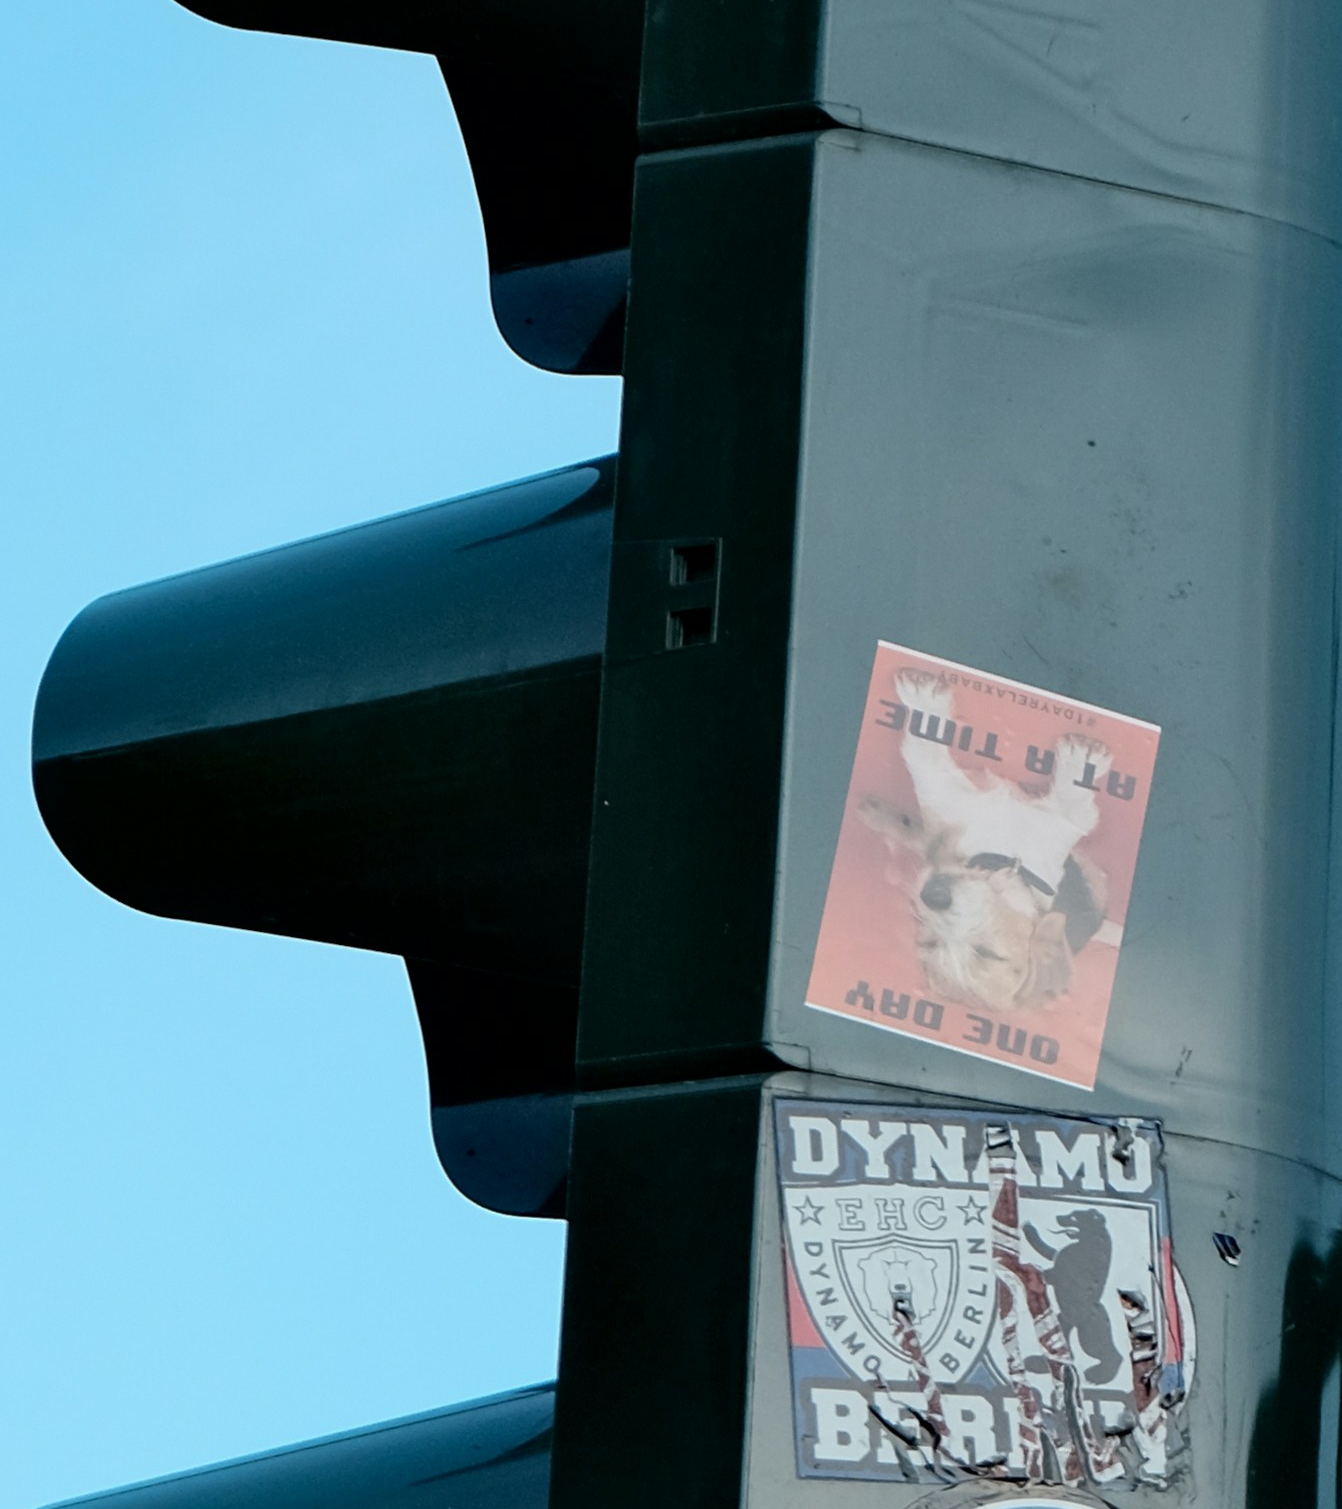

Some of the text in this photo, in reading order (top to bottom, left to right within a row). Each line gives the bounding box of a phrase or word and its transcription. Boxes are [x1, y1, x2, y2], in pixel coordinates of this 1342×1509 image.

[875, 698, 1136, 802] AT A TIME
[844, 980, 1060, 1068] ONE DAY
[789, 1115, 1155, 1193] DYNAMO
[837, 1195, 946, 1232] EHC
[802, 1240, 883, 1376] DYNAMO
[939, 1236, 987, 1372] BERLIN
